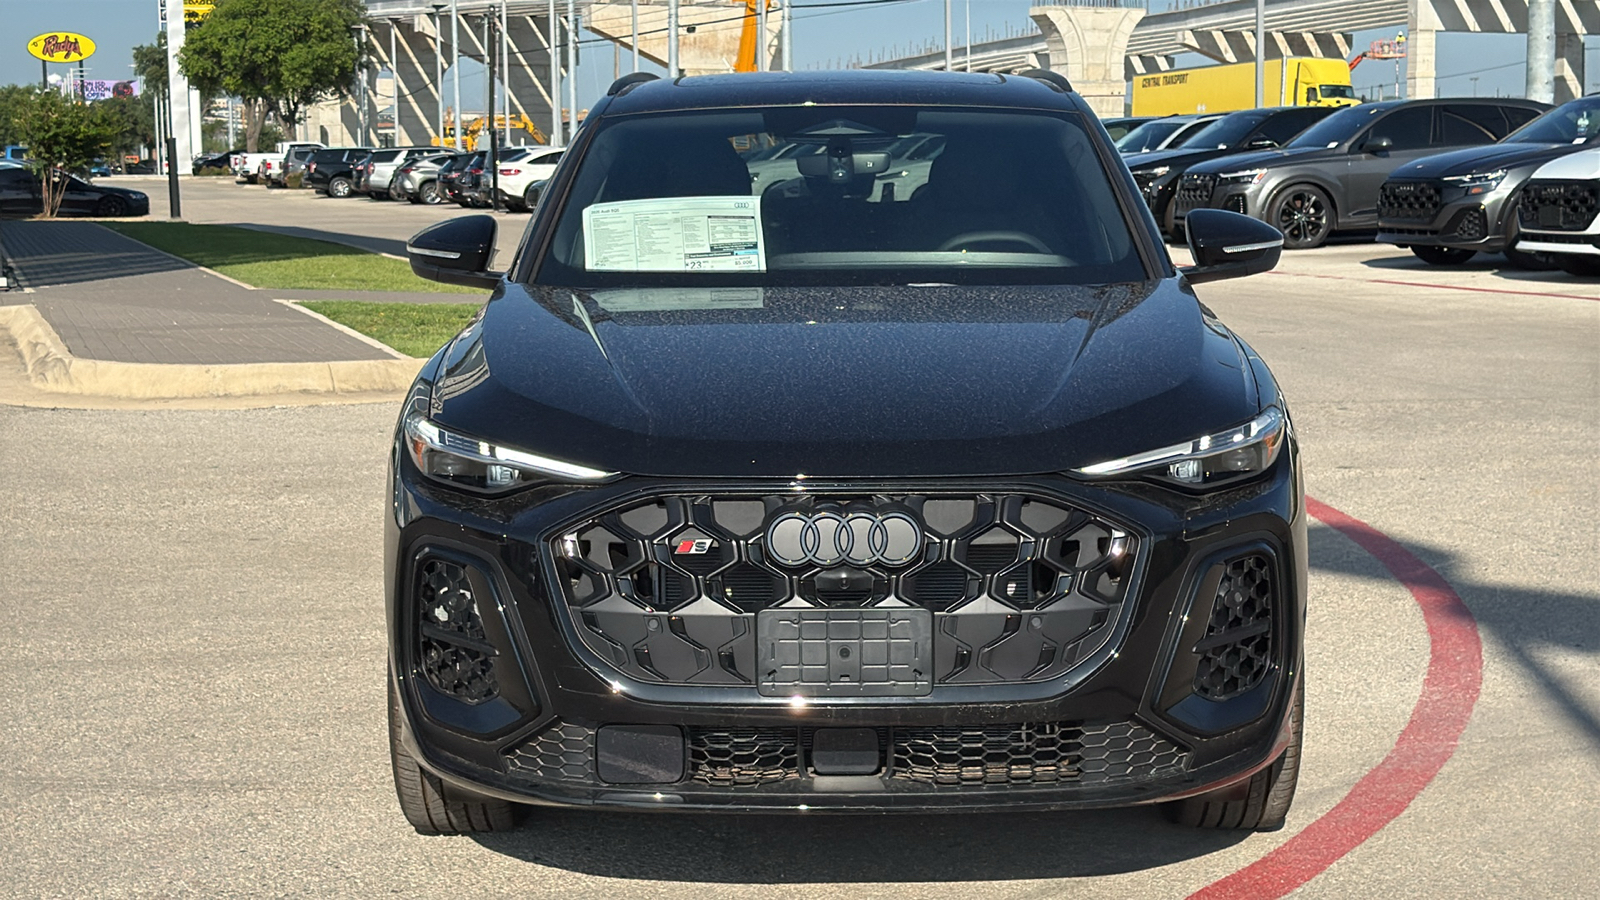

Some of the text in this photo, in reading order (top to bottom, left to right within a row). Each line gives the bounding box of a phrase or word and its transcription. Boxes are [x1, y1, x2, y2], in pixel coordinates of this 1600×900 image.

[43, 35, 82, 59] Rudy's
[1142, 73, 1188, 88] CENTRAL TRANSPORT
